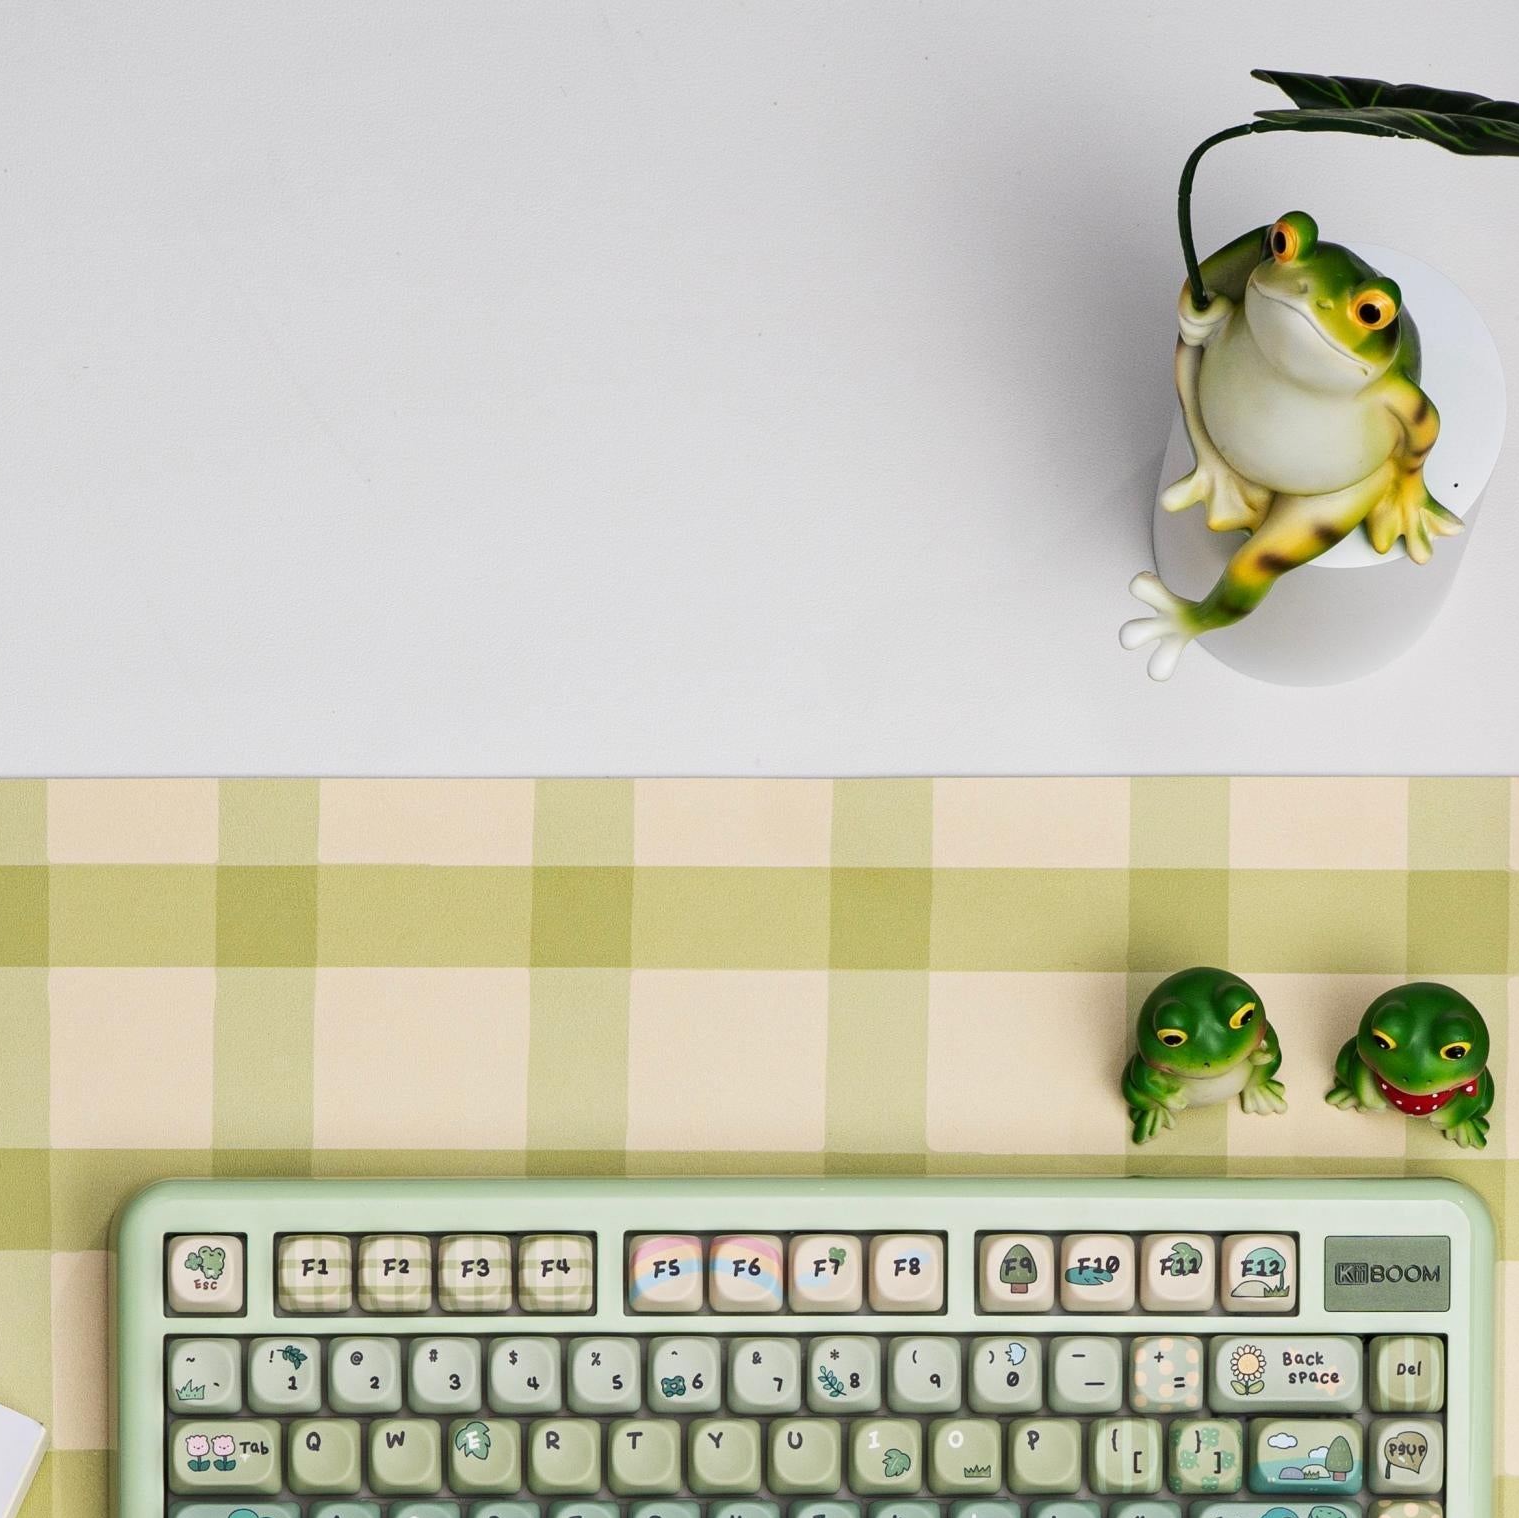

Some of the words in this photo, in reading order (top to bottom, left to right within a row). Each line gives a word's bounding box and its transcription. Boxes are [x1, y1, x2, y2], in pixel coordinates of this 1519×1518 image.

[301, 1257, 329, 1277] F1
[383, 1257, 410, 1277] F2
[461, 1257, 490, 1278] F3
[541, 1257, 570, 1277] F4
[653, 1258, 680, 1278] F5
[733, 1257, 761, 1277] F6
[813, 1256, 842, 1278] F7
[894, 1257, 921, 1276] F8
[1004, 1256, 1032, 1276] F9
[1077, 1256, 1120, 1275] F10
[1159, 1256, 1200, 1275] F11
[1241, 1257, 1281, 1276] F12
[350, 1352, 363, 1365] @
[428, 1349, 439, 1362] #
[508, 1350, 519, 1365] $
[590, 1352, 601, 1366] %
[752, 1352, 762, 1365] &
[1154, 1352, 1164, 1362] +
[1281, 1352, 1324, 1368] Back
[1288, 1369, 1340, 1388] space
[1396, 1362, 1422, 1377] Del
[287, 1376, 298, 1391] 1
[369, 1375, 380, 1390] 2
[449, 1374, 461, 1390] 3
[527, 1374, 540, 1390] 4
[611, 1374, 623, 1390] 5
[691, 1374, 703, 1390] 6
[773, 1377, 783, 1392] 7
[849, 1372, 860, 1389] 8
[930, 1373, 940, 1389] 9
[1006, 1371, 1020, 1387] 0
[1173, 1376, 1185, 1389] =
[239, 1440, 269, 1455] Tab
[305, 1431, 322, 1453] Q
[386, 1431, 405, 1449] W
[465, 1428, 481, 1449] E
[545, 1431, 560, 1450] R
[626, 1431, 643, 1450] T
[708, 1431, 724, 1449] Y
[787, 1430, 803, 1450] U
[867, 1430, 880, 1449] I
[947, 1430, 964, 1449] O
[1027, 1431, 1040, 1450] P
[1133, 1452, 1143, 1473] [
